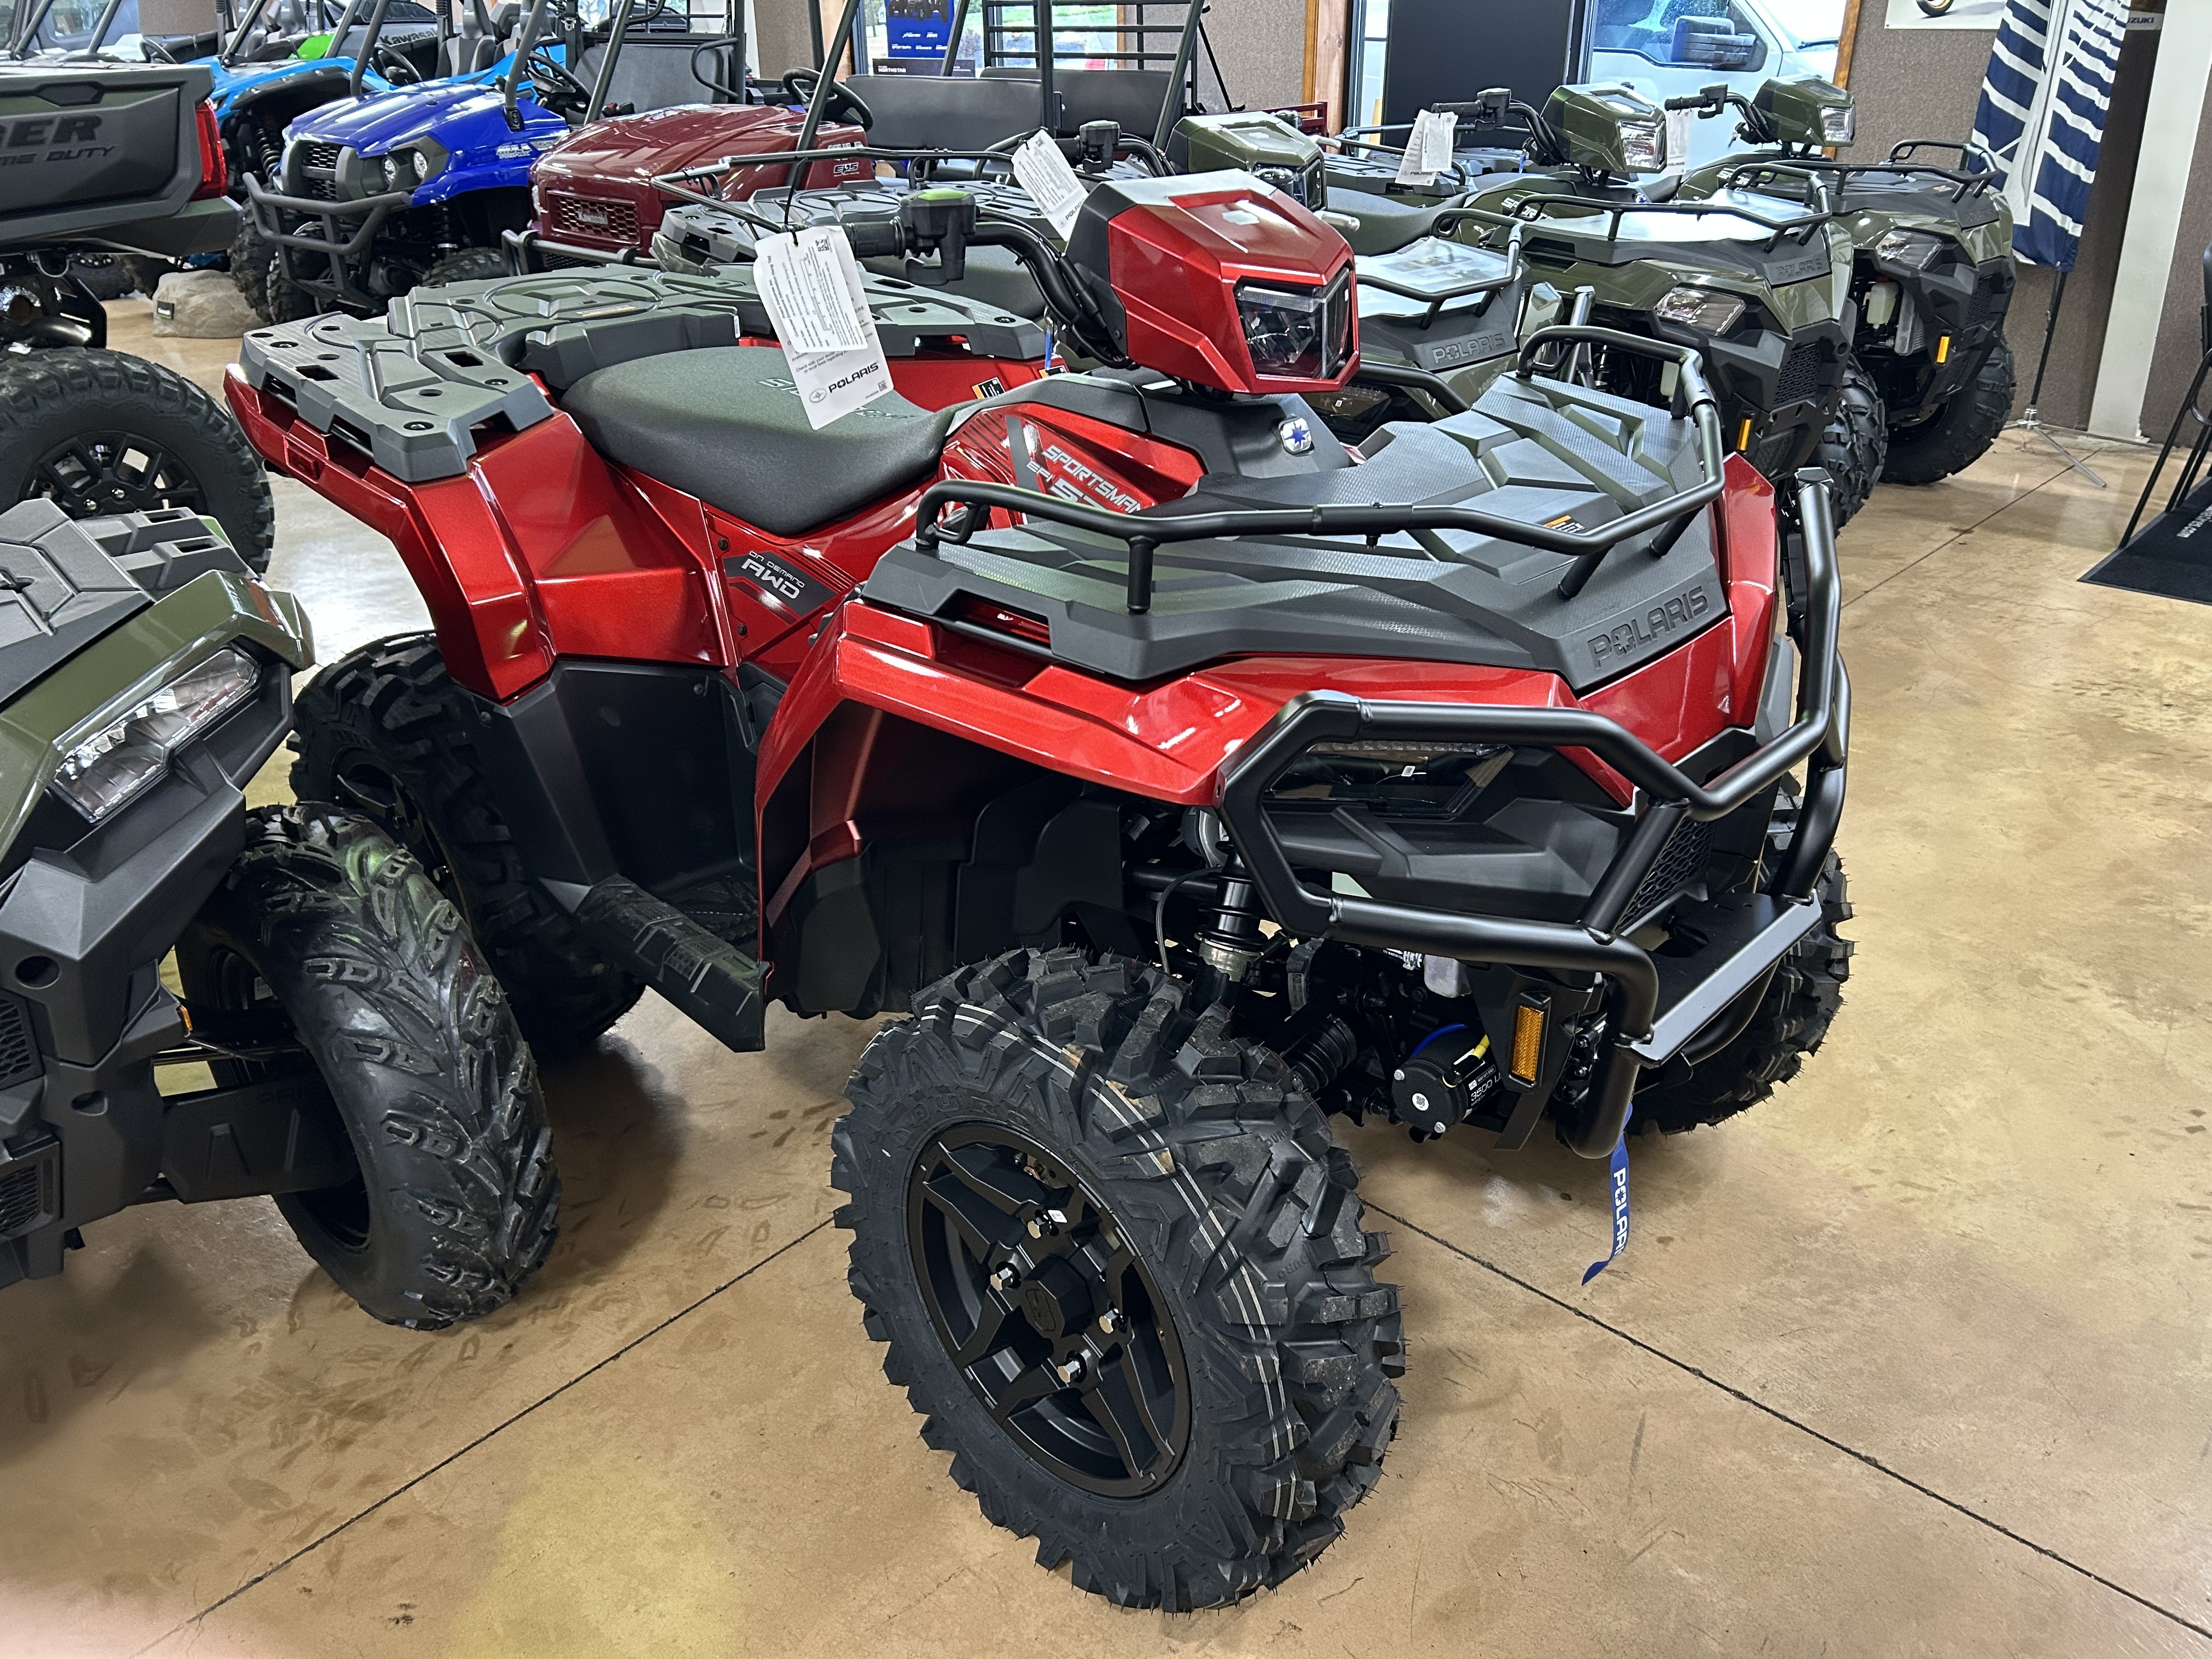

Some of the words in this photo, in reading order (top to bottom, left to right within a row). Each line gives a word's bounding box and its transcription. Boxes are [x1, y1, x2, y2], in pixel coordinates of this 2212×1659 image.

[46, 145, 117, 162] DUTY
[1432, 333, 1506, 364] POLARIS
[828, 362, 879, 393] POLARIS
[1026, 460, 1054, 482] EFI
[741, 558, 800, 599] AWD
[749, 550, 765, 562] ON
[766, 561, 805, 589] DEMAND
[1587, 585, 1709, 670] POLARIS
[1471, 1079, 1493, 1102] 3500
[1613, 1167, 1628, 1256] POLARI
